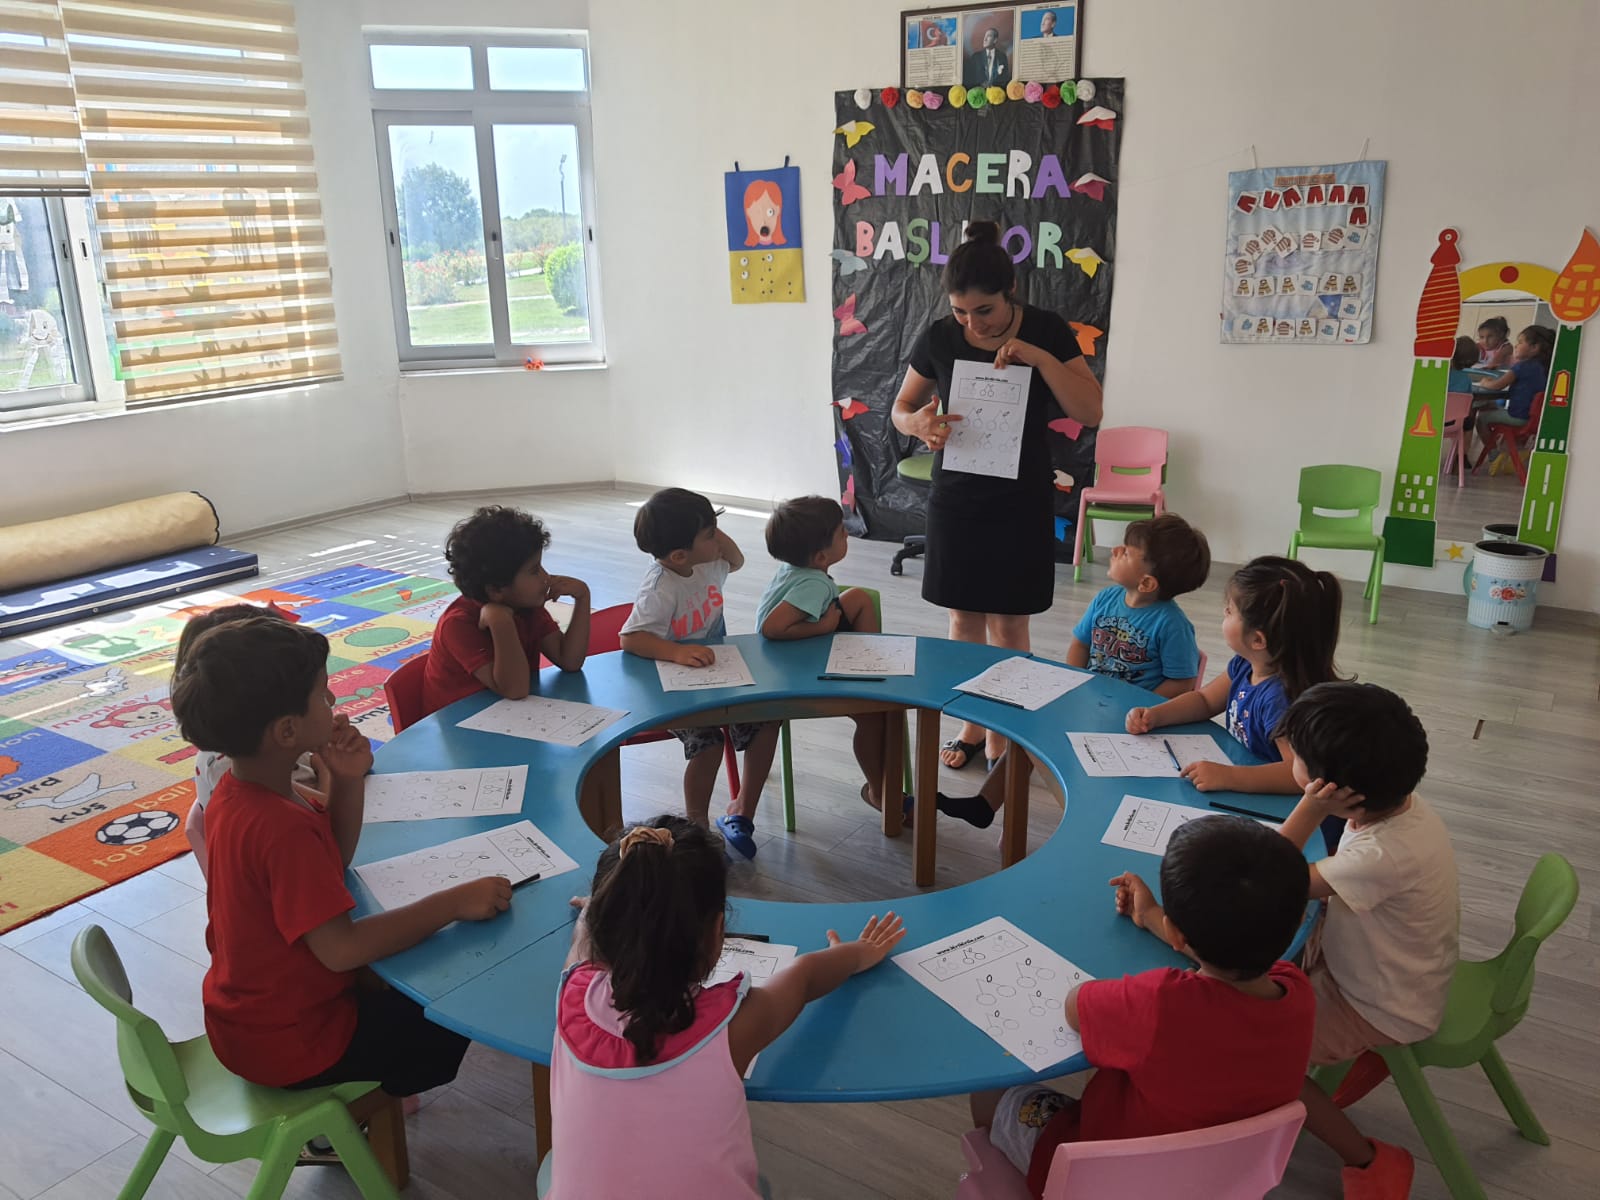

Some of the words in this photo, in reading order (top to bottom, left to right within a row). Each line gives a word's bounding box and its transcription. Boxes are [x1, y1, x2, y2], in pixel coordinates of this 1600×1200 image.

[874, 149, 1072, 199] MACERA
[855, 218, 1064, 269] BAŞLOR
[365, 631, 434, 657] yuvarla
[328, 669, 366, 686] ake
[52, 694, 150, 730] monkey
[0, 732, 42, 749] ion
[0, 776, 62, 802] bird
[133, 785, 193, 810] ball
[92, 843, 148, 867] top
